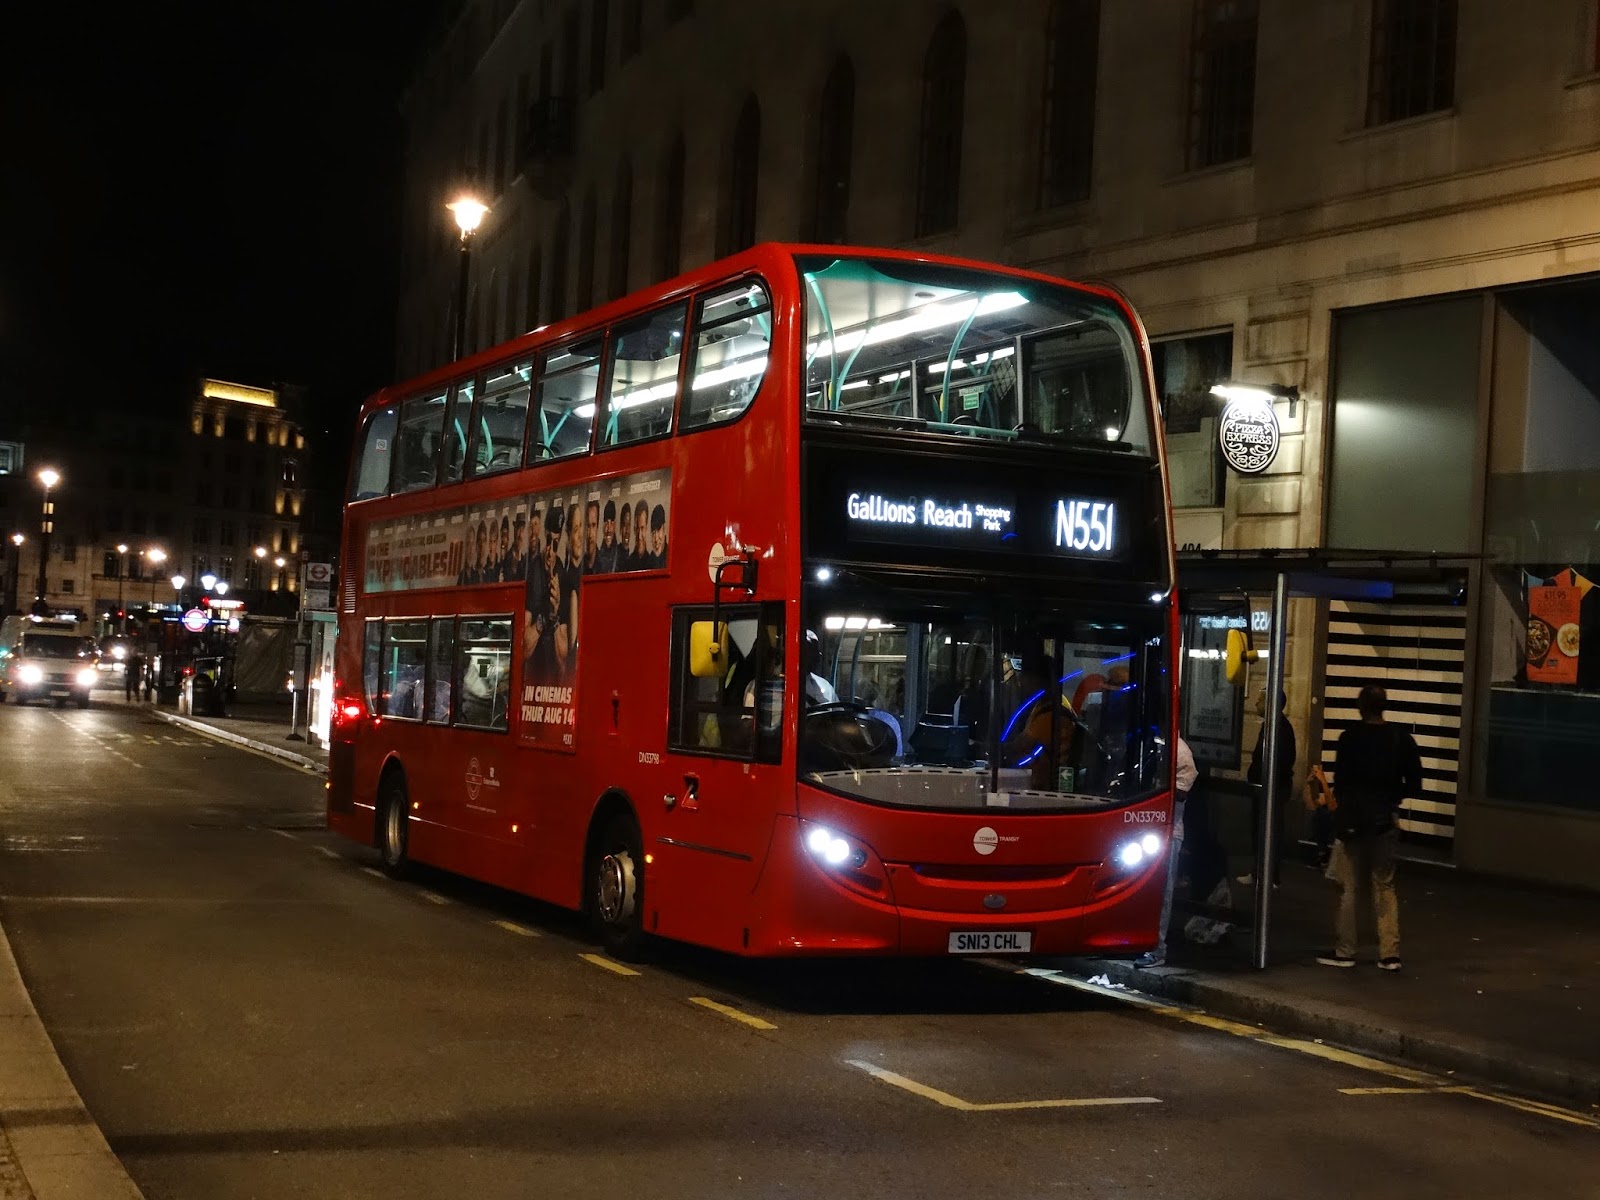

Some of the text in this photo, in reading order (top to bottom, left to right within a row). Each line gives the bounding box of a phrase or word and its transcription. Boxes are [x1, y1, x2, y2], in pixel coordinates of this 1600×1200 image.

[1235, 423, 1265, 435] PIZZA
[1226, 431, 1272, 445] EXPRESS
[847, 493, 973, 529] Gallions Reach
[1056, 499, 1116, 551] N551
[525, 686, 573, 704] IN CINEMAS
[521, 705, 575, 726] THUR AUG 14
[1123, 811, 1167, 823] DN33798
[957, 934, 1022, 950] SN13 CHL
